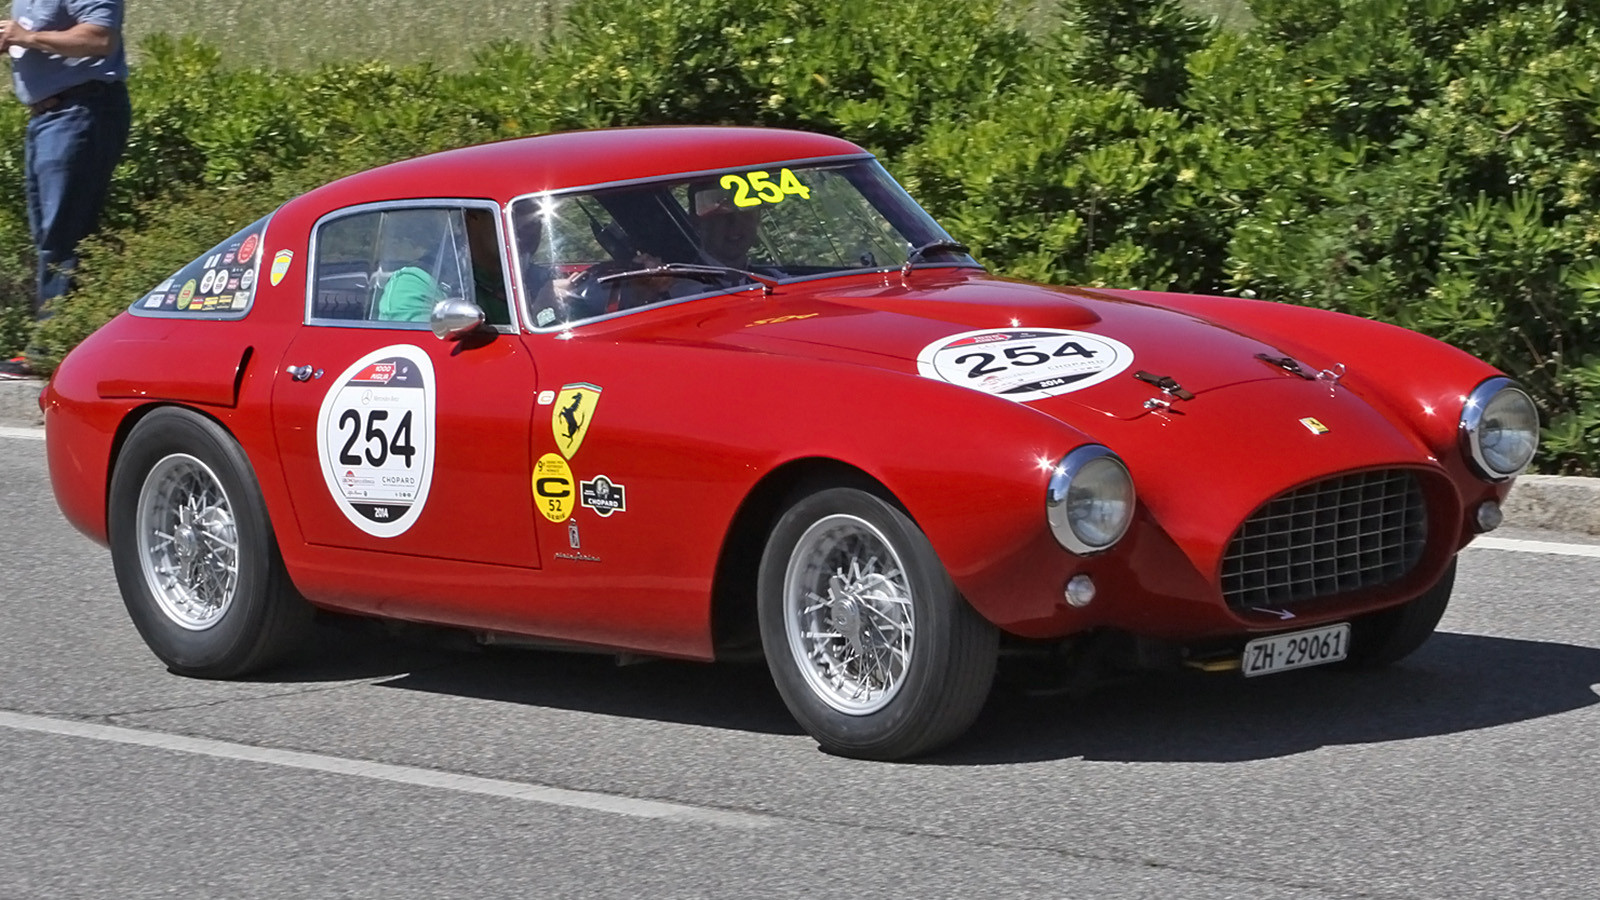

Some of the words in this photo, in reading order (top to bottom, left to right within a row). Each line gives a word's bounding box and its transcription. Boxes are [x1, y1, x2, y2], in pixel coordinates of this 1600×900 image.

[720, 168, 811, 207] 254
[955, 341, 1098, 378] 254
[1040, 378, 1065, 388] 2014
[338, 409, 416, 468] 254
[381, 476, 415, 484] CHOPARD
[536, 477, 571, 498] C
[549, 499, 562, 512] 52
[588, 498, 619, 508] CHOPARD
